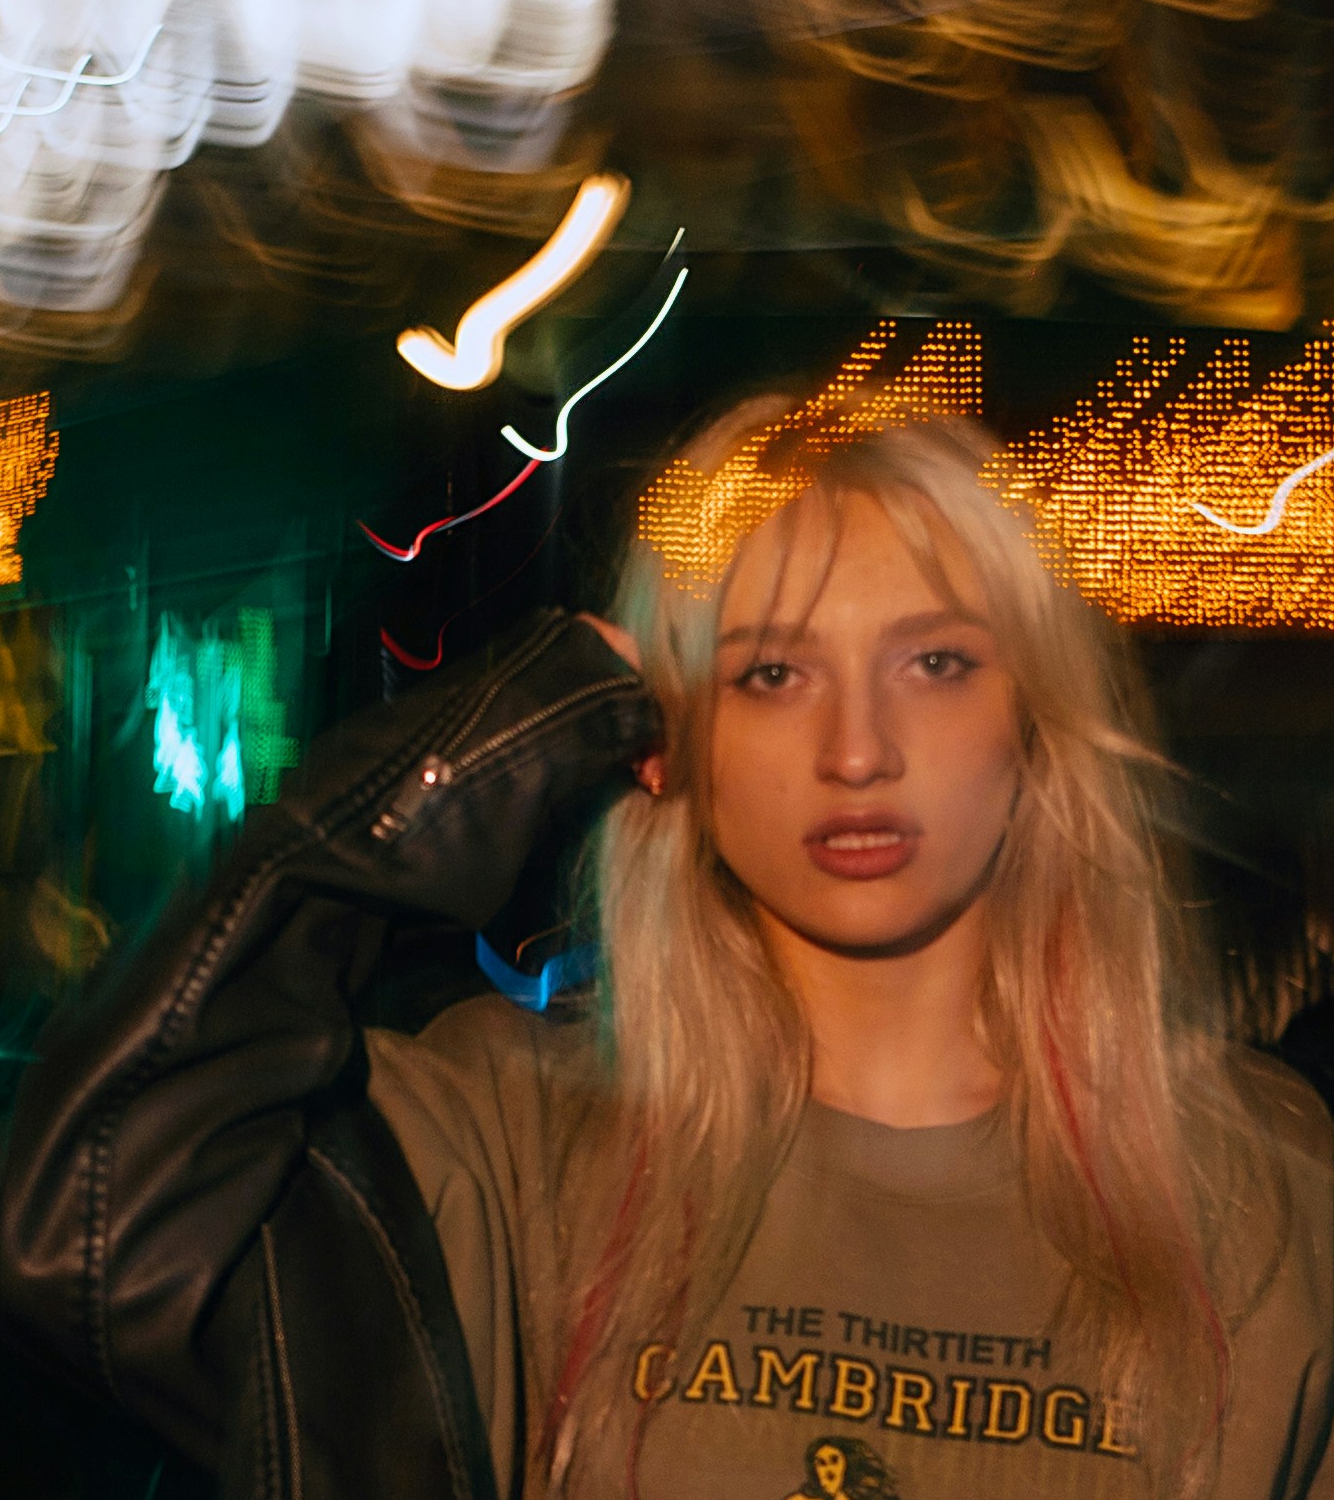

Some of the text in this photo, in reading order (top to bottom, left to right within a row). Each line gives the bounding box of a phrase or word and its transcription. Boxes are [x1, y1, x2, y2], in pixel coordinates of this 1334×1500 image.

[742, 1304, 1053, 1371] THE THIRTIETH
[631, 1339, 1142, 1461] CAMBRIDGE
